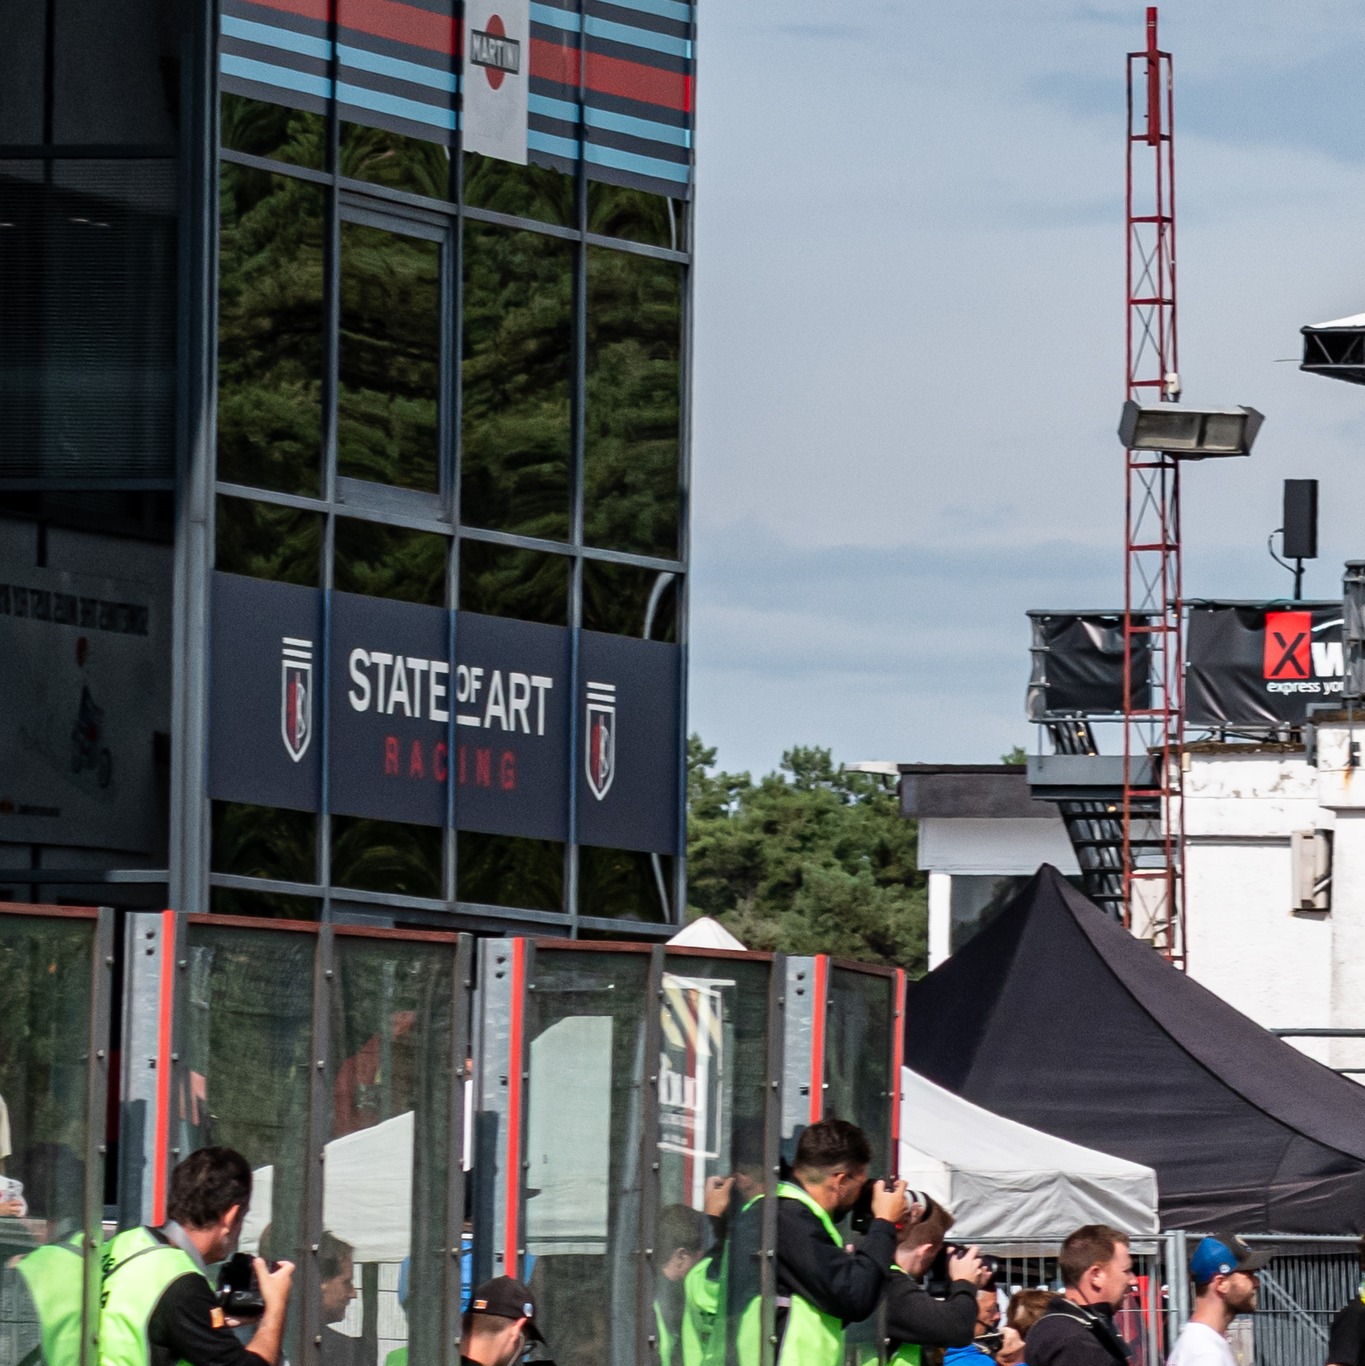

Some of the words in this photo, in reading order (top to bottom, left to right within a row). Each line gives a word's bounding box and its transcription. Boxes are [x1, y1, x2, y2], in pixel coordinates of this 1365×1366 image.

[471, 34, 520, 70] MARTINI
[348, 648, 449, 722] STATE
[456, 664, 484, 704] OF
[484, 670, 553, 736] ART
[1266, 681, 1321, 696] express
[383, 736, 517, 791] RACING
